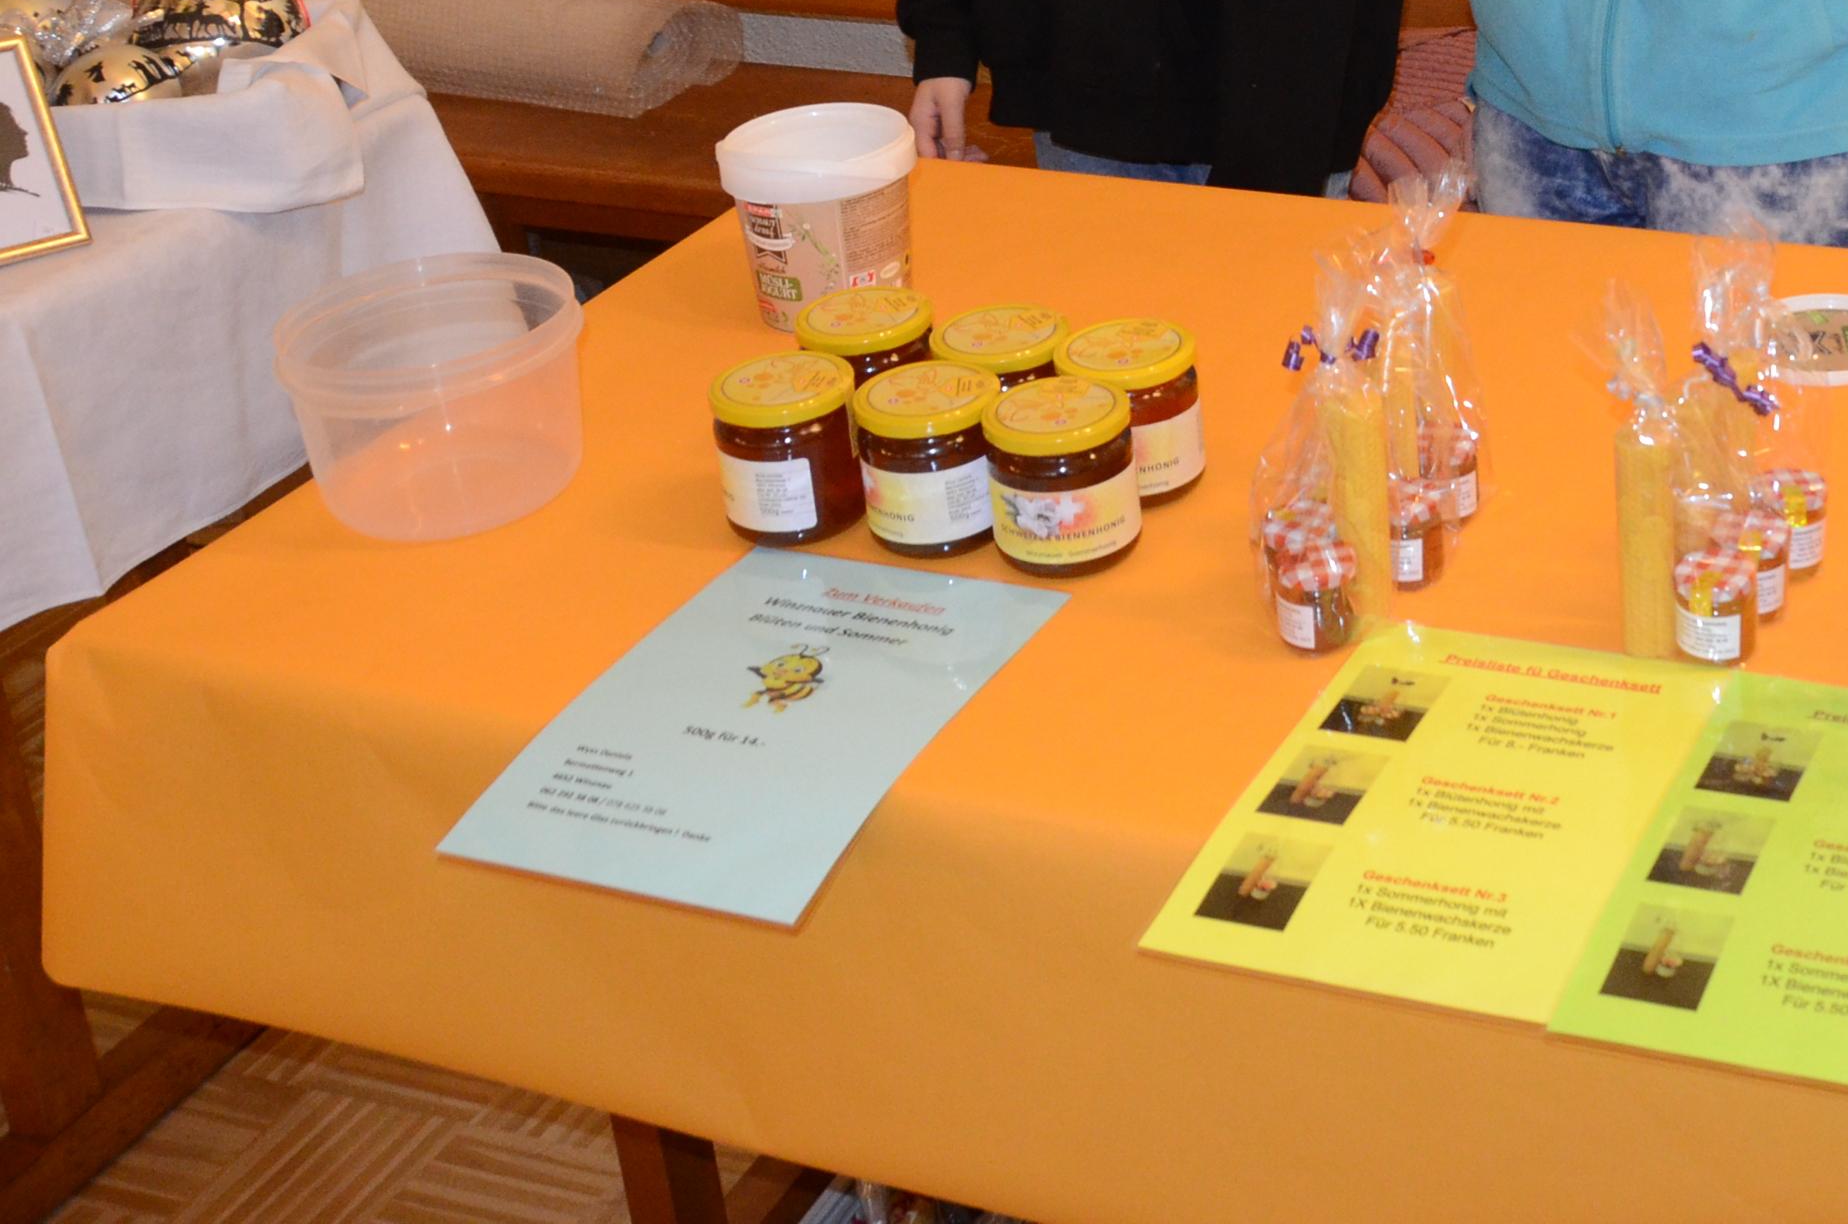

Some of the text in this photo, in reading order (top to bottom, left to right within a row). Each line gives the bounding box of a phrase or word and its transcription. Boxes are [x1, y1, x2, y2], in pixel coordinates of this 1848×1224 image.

[1054, 516, 1127, 542] BIENENHONIG
[764, 597, 955, 636] Winznauer Bienenhonig
[864, 592, 946, 616] Verkaufen
[749, 613, 907, 647] Blüten und Sommer
[1442, 654, 1521, 673] Preisliste
[1547, 669, 1662, 695] Geschenksett
[1485, 694, 1584, 715] Geschenksett
[1498, 705, 1579, 726] Blütenhonig
[682, 725, 715, 742] 500g
[718, 730, 739, 743] für
[1484, 725, 1614, 752] Bienenwachskerze
[1492, 715, 1587, 738] Sommerhonig
[1478, 735, 1502, 748] Für
[1527, 742, 1585, 760] Franken
[1422, 775, 1561, 806] Geschenksett Nr.2
[1434, 789, 1518, 813] Blütenhonig
[1522, 804, 1545, 815] mit
[1427, 800, 1562, 830] Bienenwachskerze
[1484, 822, 1545, 840] Franken
[1363, 869, 1509, 903] Geschenksett Nr.3
[1820, 879, 1845, 891] Für
[1357, 883, 1509, 919] 1x Sommerhonig mit
[1370, 900, 1512, 936] Bienenwachskerze
[1365, 915, 1496, 950] Für 5.50 Franken
[1782, 994, 1810, 1009] Für
